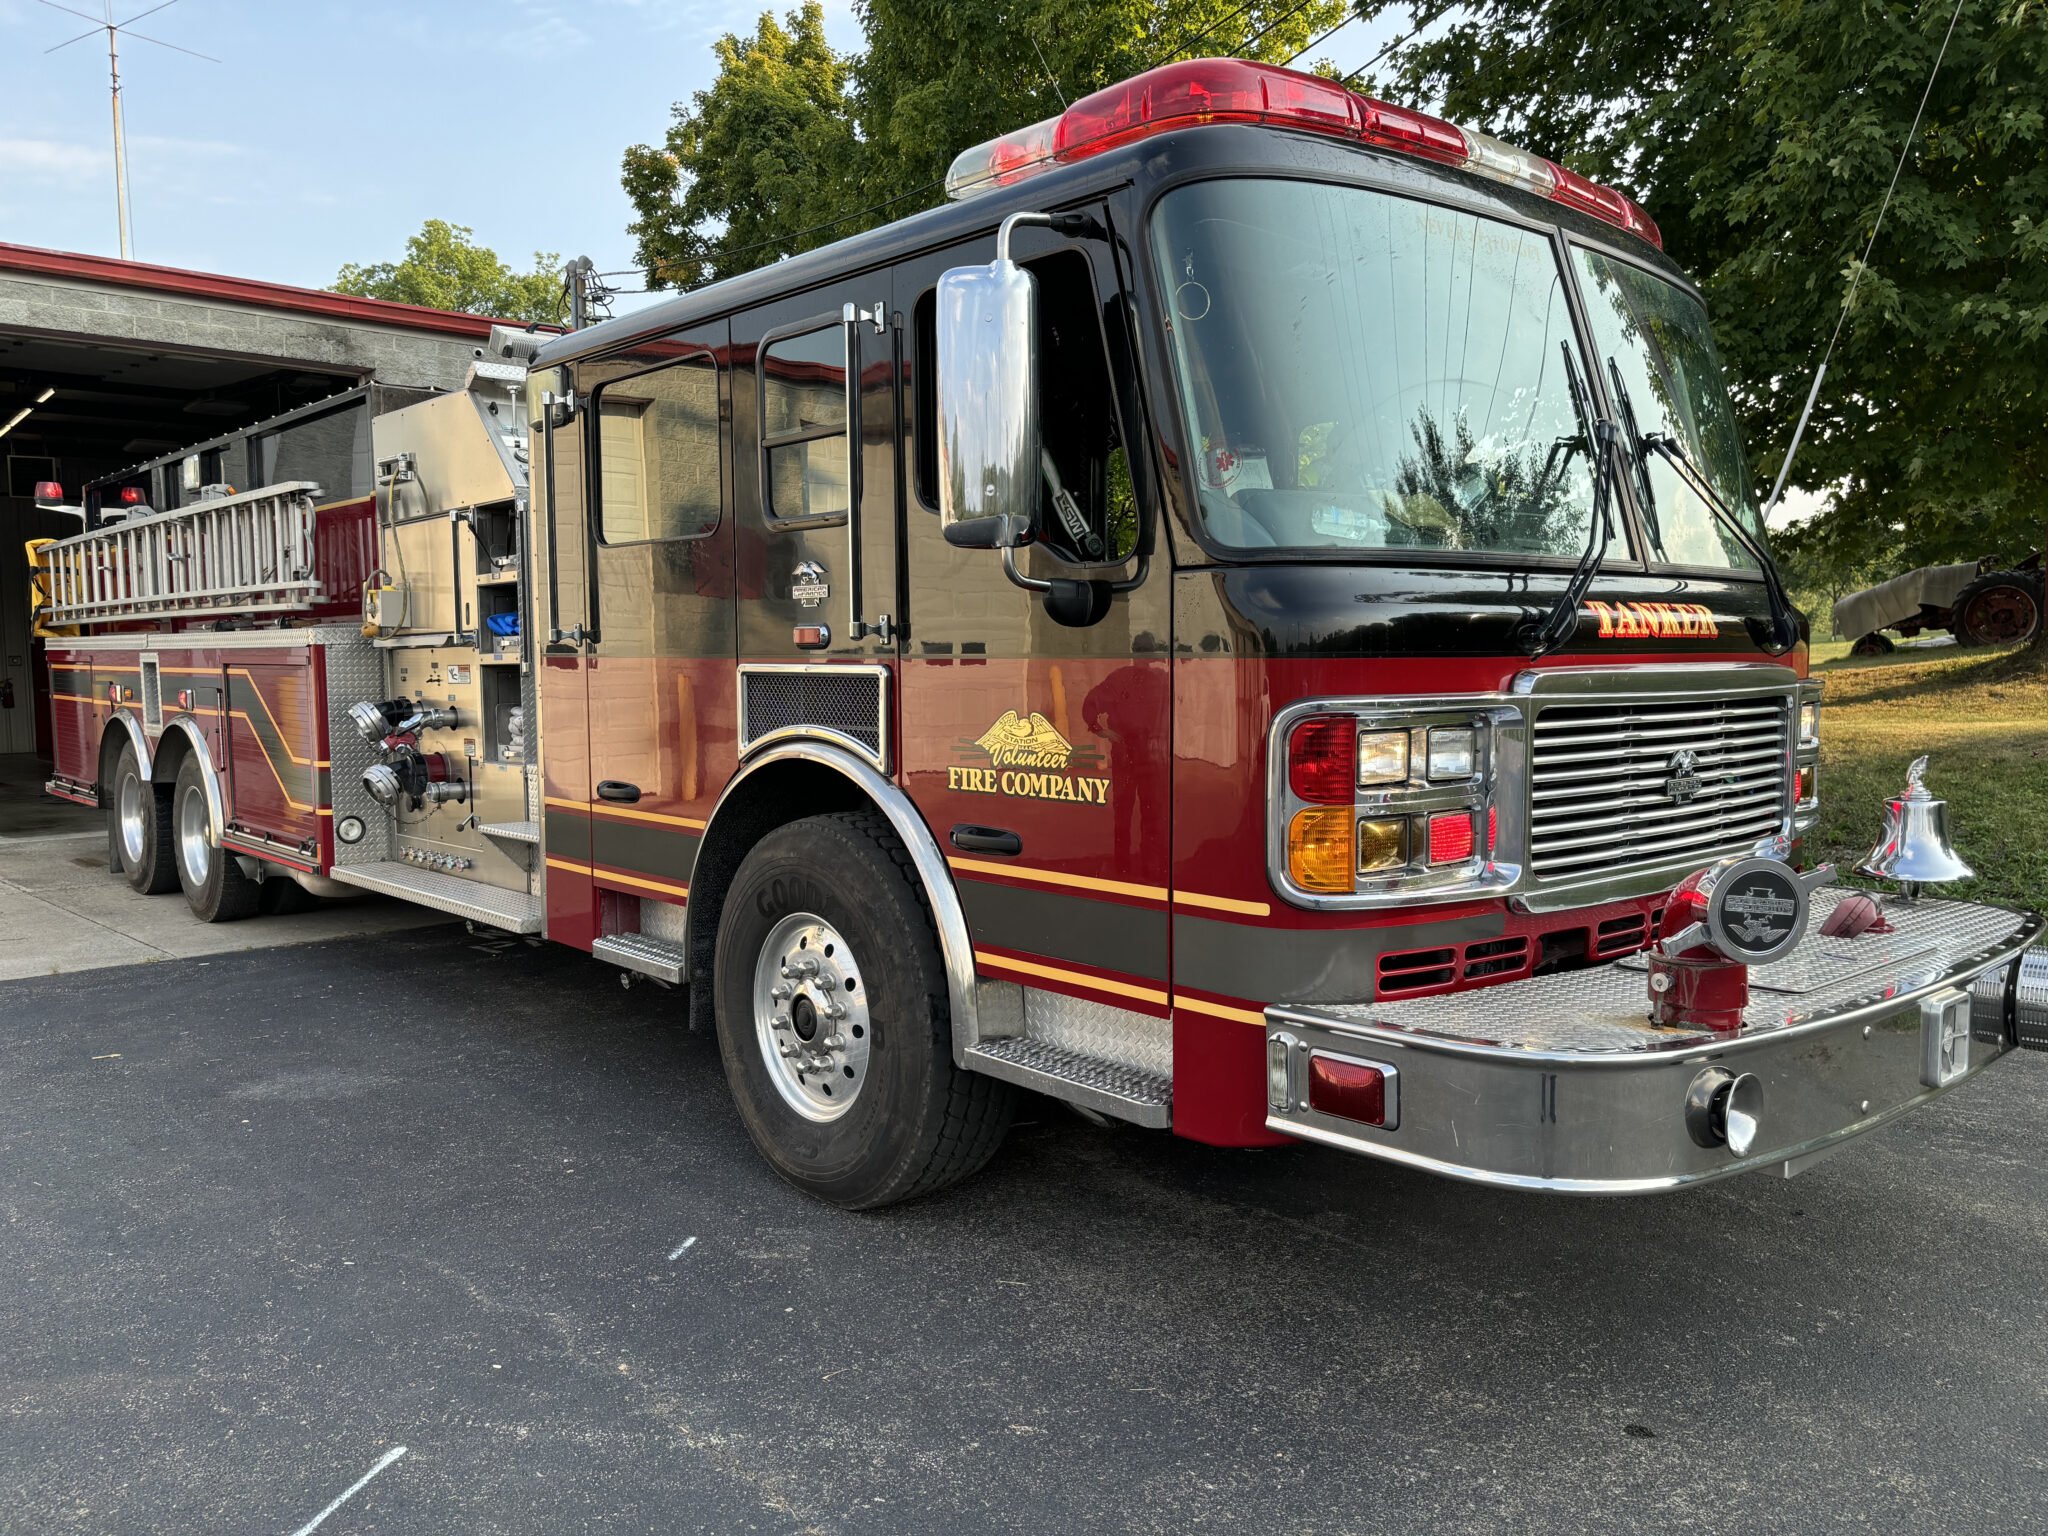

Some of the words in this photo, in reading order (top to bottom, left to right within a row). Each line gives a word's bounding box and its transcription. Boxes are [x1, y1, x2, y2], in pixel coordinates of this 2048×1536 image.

[1059, 495, 1083, 533] MSA
[1584, 600, 1719, 638] TANKER
[989, 743, 1068, 769] Volunteer
[1003, 733, 1039, 745] STATION
[948, 766, 998, 793] FIRE
[1001, 771, 1110, 804] COMPANY
